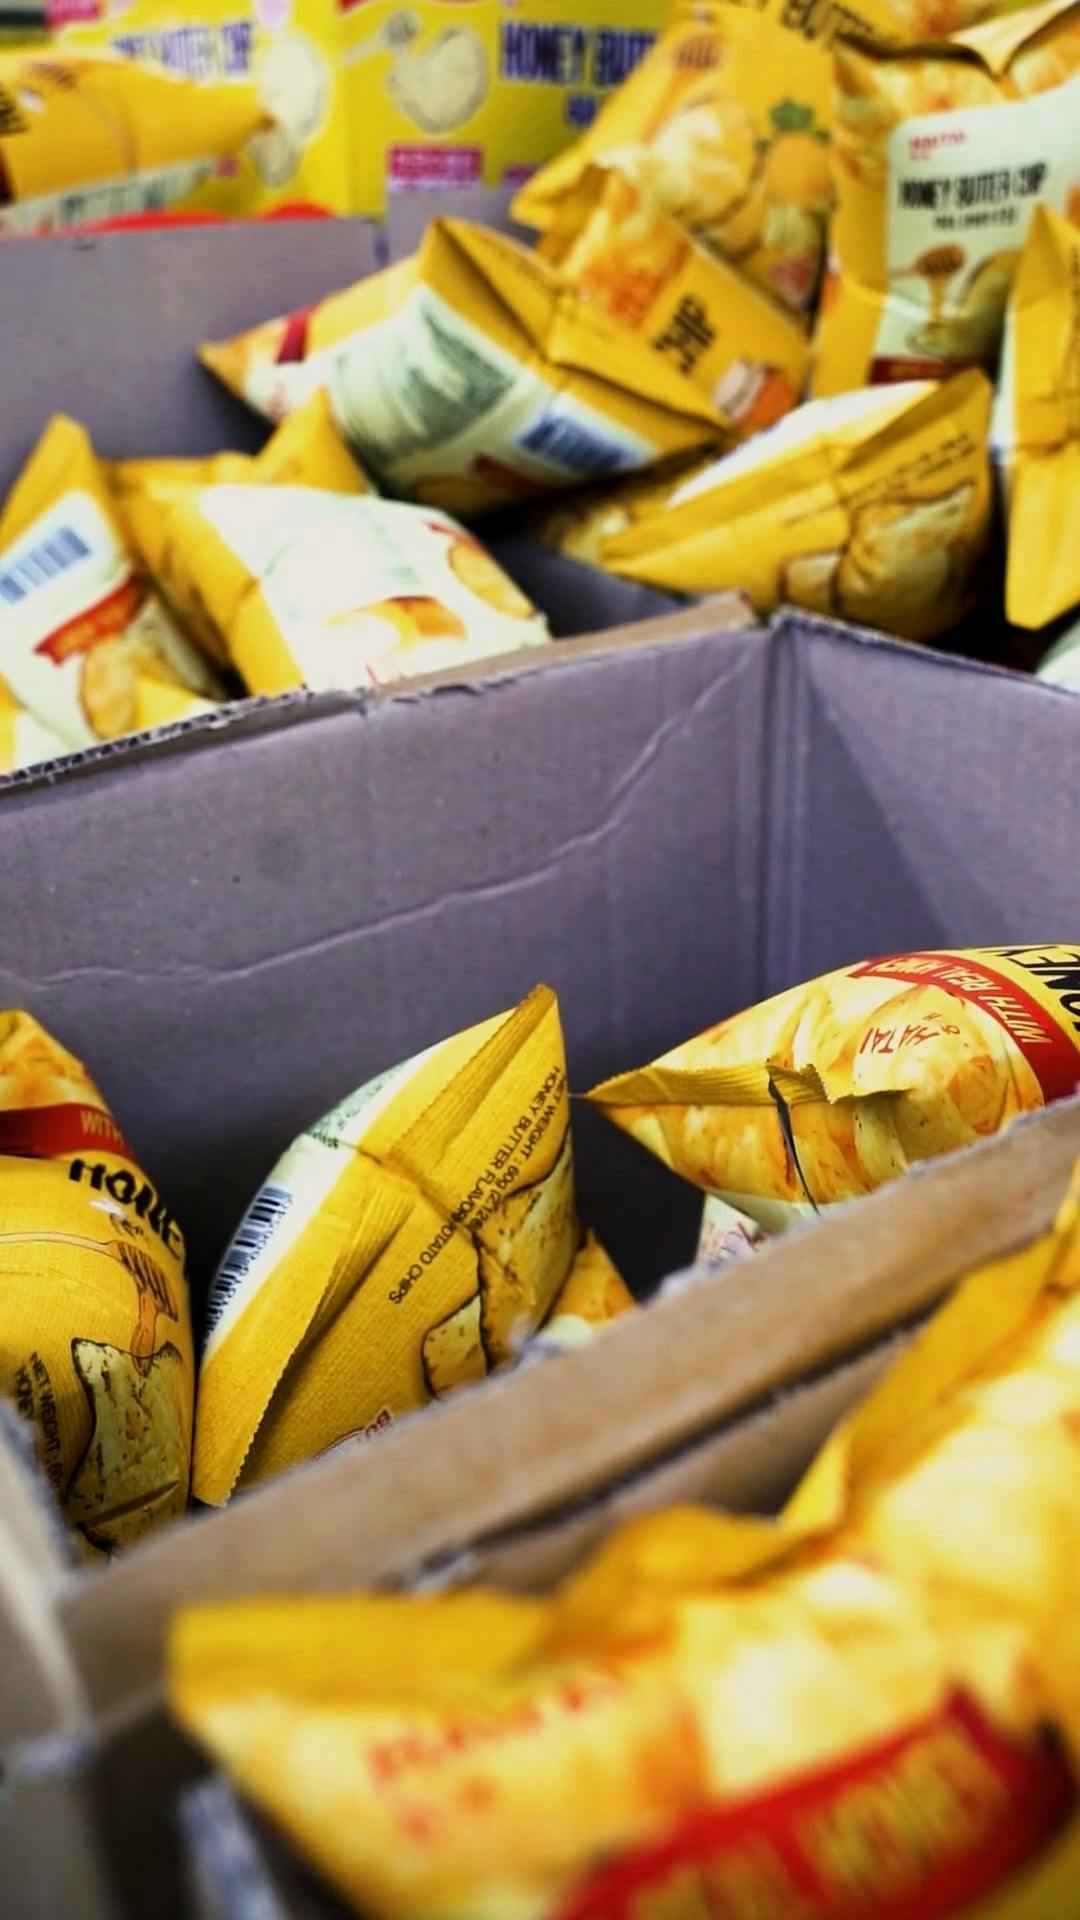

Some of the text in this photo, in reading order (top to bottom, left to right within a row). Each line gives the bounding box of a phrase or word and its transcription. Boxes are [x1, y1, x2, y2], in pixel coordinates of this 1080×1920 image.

[932, 963, 1003, 992] REAL
[979, 995, 1055, 1044] WITH
[530, 1066, 561, 1117] HONEY
[490, 1115, 532, 1171] BUTTER
[519, 1104, 557, 1161] WEIGHT
[495, 1164, 521, 1190] 60g
[69, 1157, 183, 1264] HONE
[388, 1264, 423, 1304] CHIPS
[30, 1351, 51, 1390] NET
[38, 1389, 61, 1451] WEIGHT
